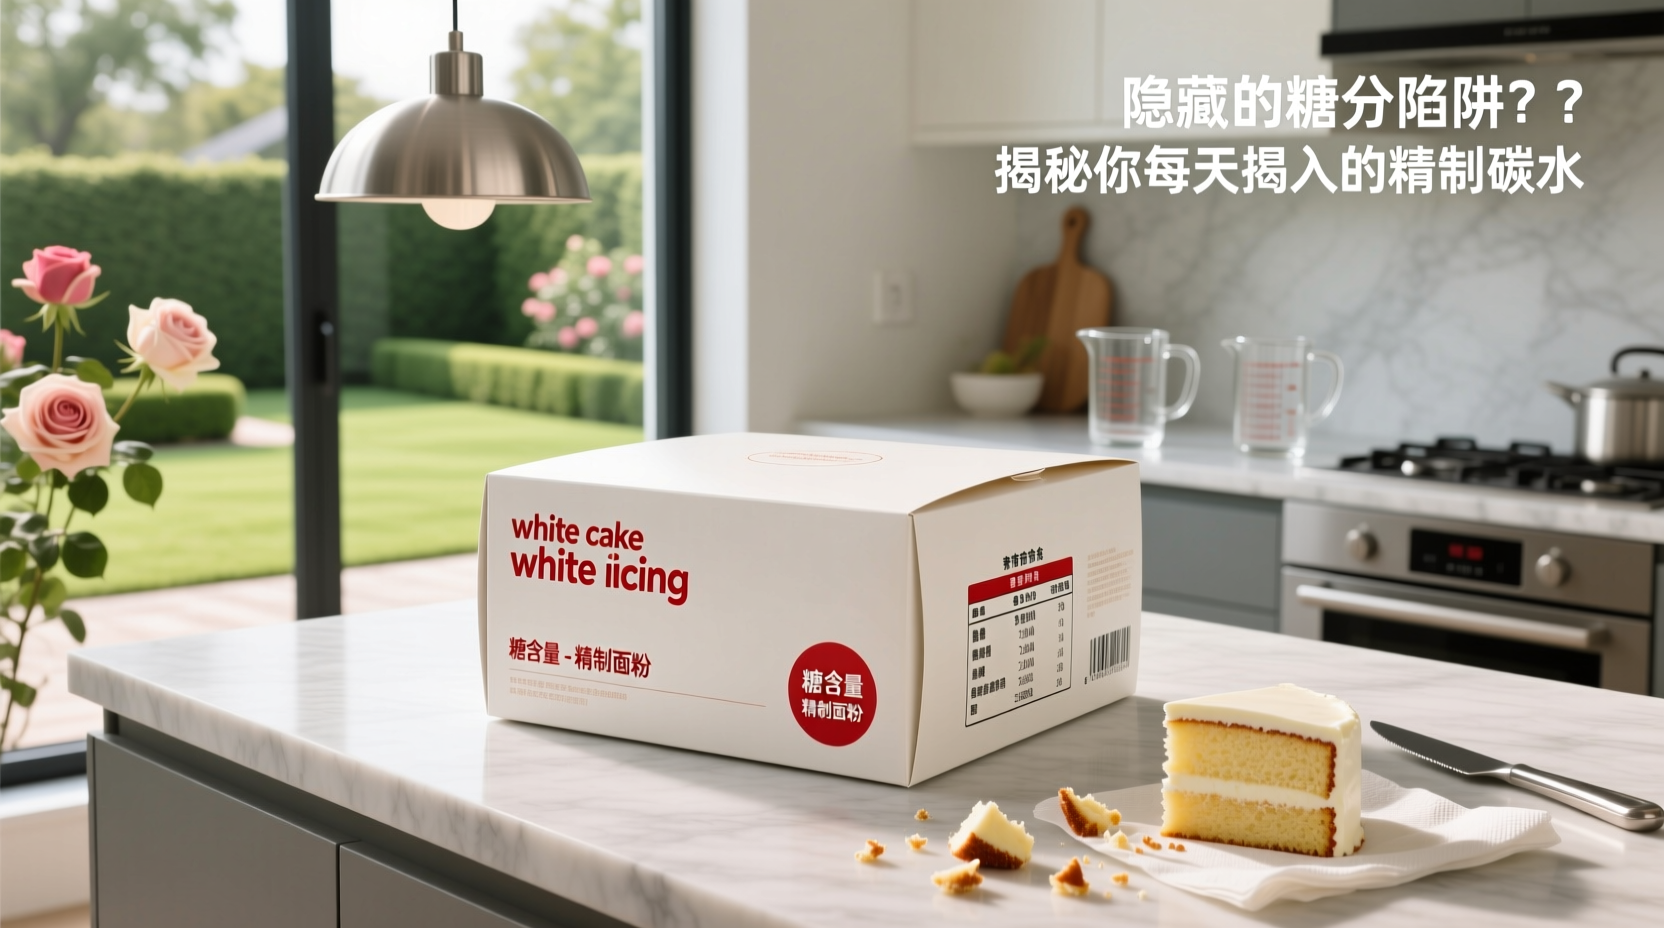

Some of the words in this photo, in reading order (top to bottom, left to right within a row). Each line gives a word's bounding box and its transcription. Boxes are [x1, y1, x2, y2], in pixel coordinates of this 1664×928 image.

[511, 512, 581, 545] white
[585, 520, 645, 552] cake
[509, 545, 597, 587] white
[801, 668, 864, 699] 糖含量
